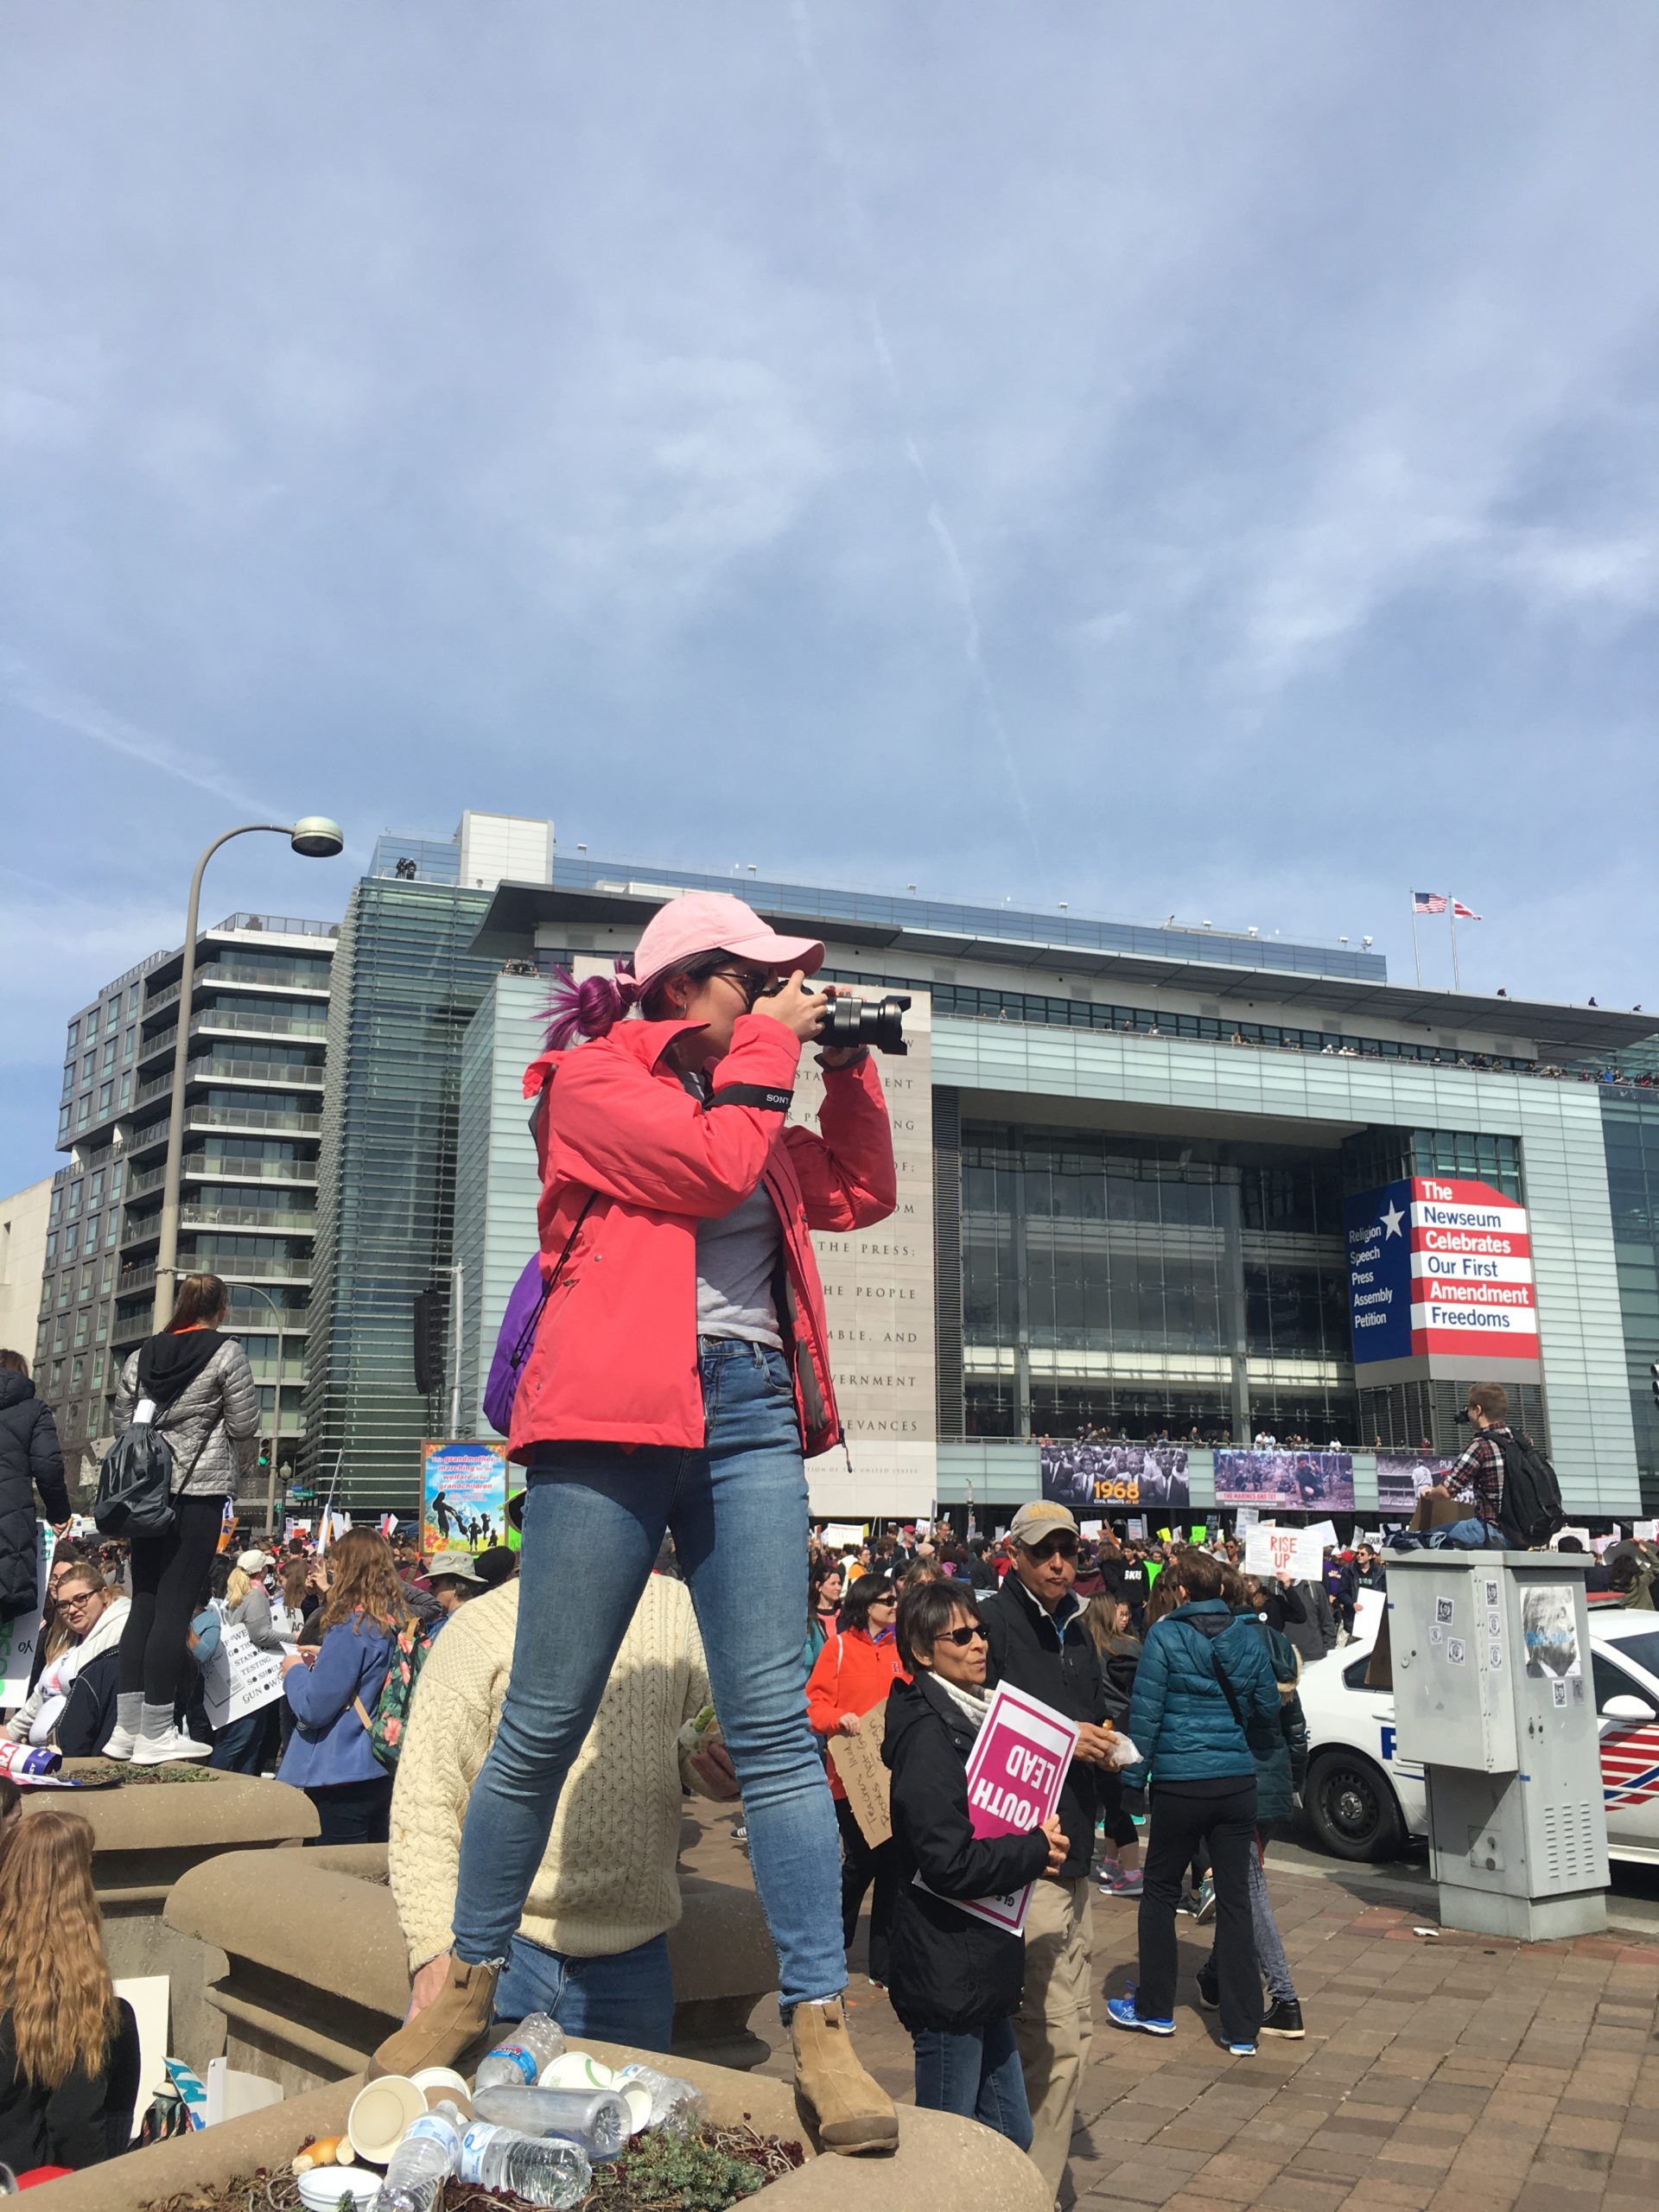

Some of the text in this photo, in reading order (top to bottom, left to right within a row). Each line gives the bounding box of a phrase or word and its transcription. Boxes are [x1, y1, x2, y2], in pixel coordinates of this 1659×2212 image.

[1421, 1181, 1452, 1200] The
[1424, 1206, 1502, 1228] Newseum
[1349, 1225, 1382, 1243] Religion
[1426, 1230, 1511, 1254] Celebrates
[817, 1242, 915, 1256] THE PRESS;
[1350, 1246, 1380, 1266] Speech
[1427, 1256, 1498, 1277] Our First
[1351, 1271, 1374, 1286] Press
[823, 1286, 916, 1299] HE PEOPLE
[1354, 1287, 1393, 1307] Assembly
[1430, 1281, 1529, 1304] Amendment
[1354, 1312, 1387, 1329] Petition
[1432, 1306, 1510, 1327] Freedoms
[884, 1332, 917, 1342] AND
[1440, 1459, 1452, 1469] PUL
[1094, 1481, 1140, 1499] 1968
[1270, 1535, 1298, 1553] RISE
[1274, 1553, 1290, 1568] UP
[242, 1688, 263, 1705] GUN
[1006, 1745, 1056, 1795] LEAD
[971, 1777, 1040, 1832] YOUTH
